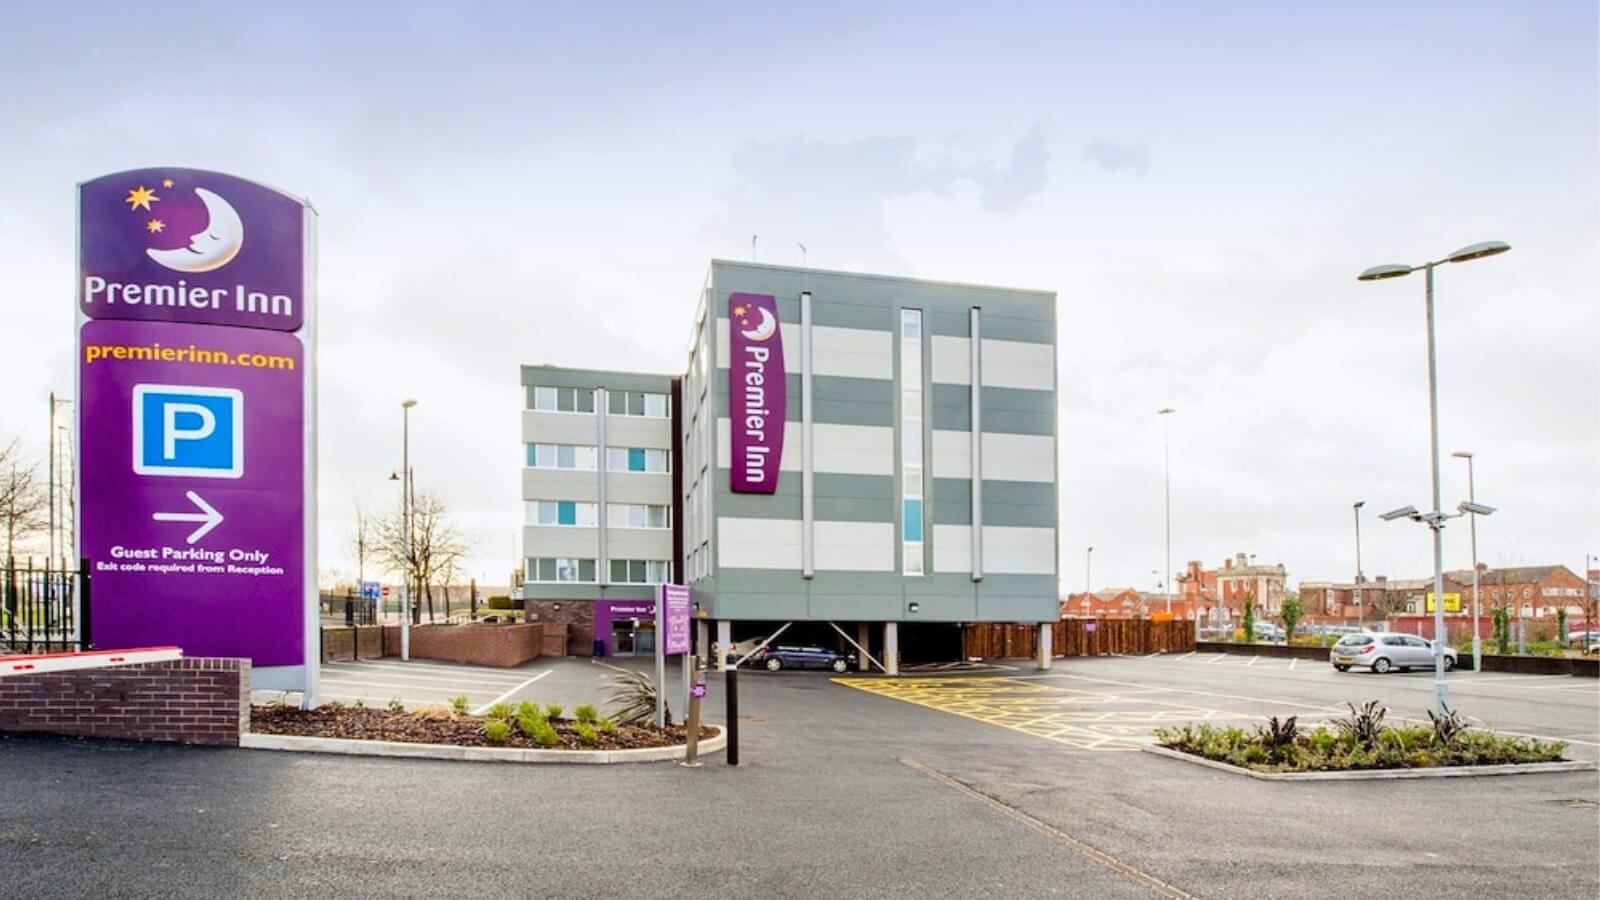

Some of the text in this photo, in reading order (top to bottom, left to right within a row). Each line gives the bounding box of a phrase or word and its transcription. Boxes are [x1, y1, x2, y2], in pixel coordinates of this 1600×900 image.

[84, 276, 292, 316] Premier Inn
[86, 343, 295, 370] premierinn.com
[163, 402, 217, 460] P
[745, 346, 770, 483] Premier Inn
[97, 561, 284, 576] Exit code required from Reception
[111, 546, 270, 564] Guest Parking Only
